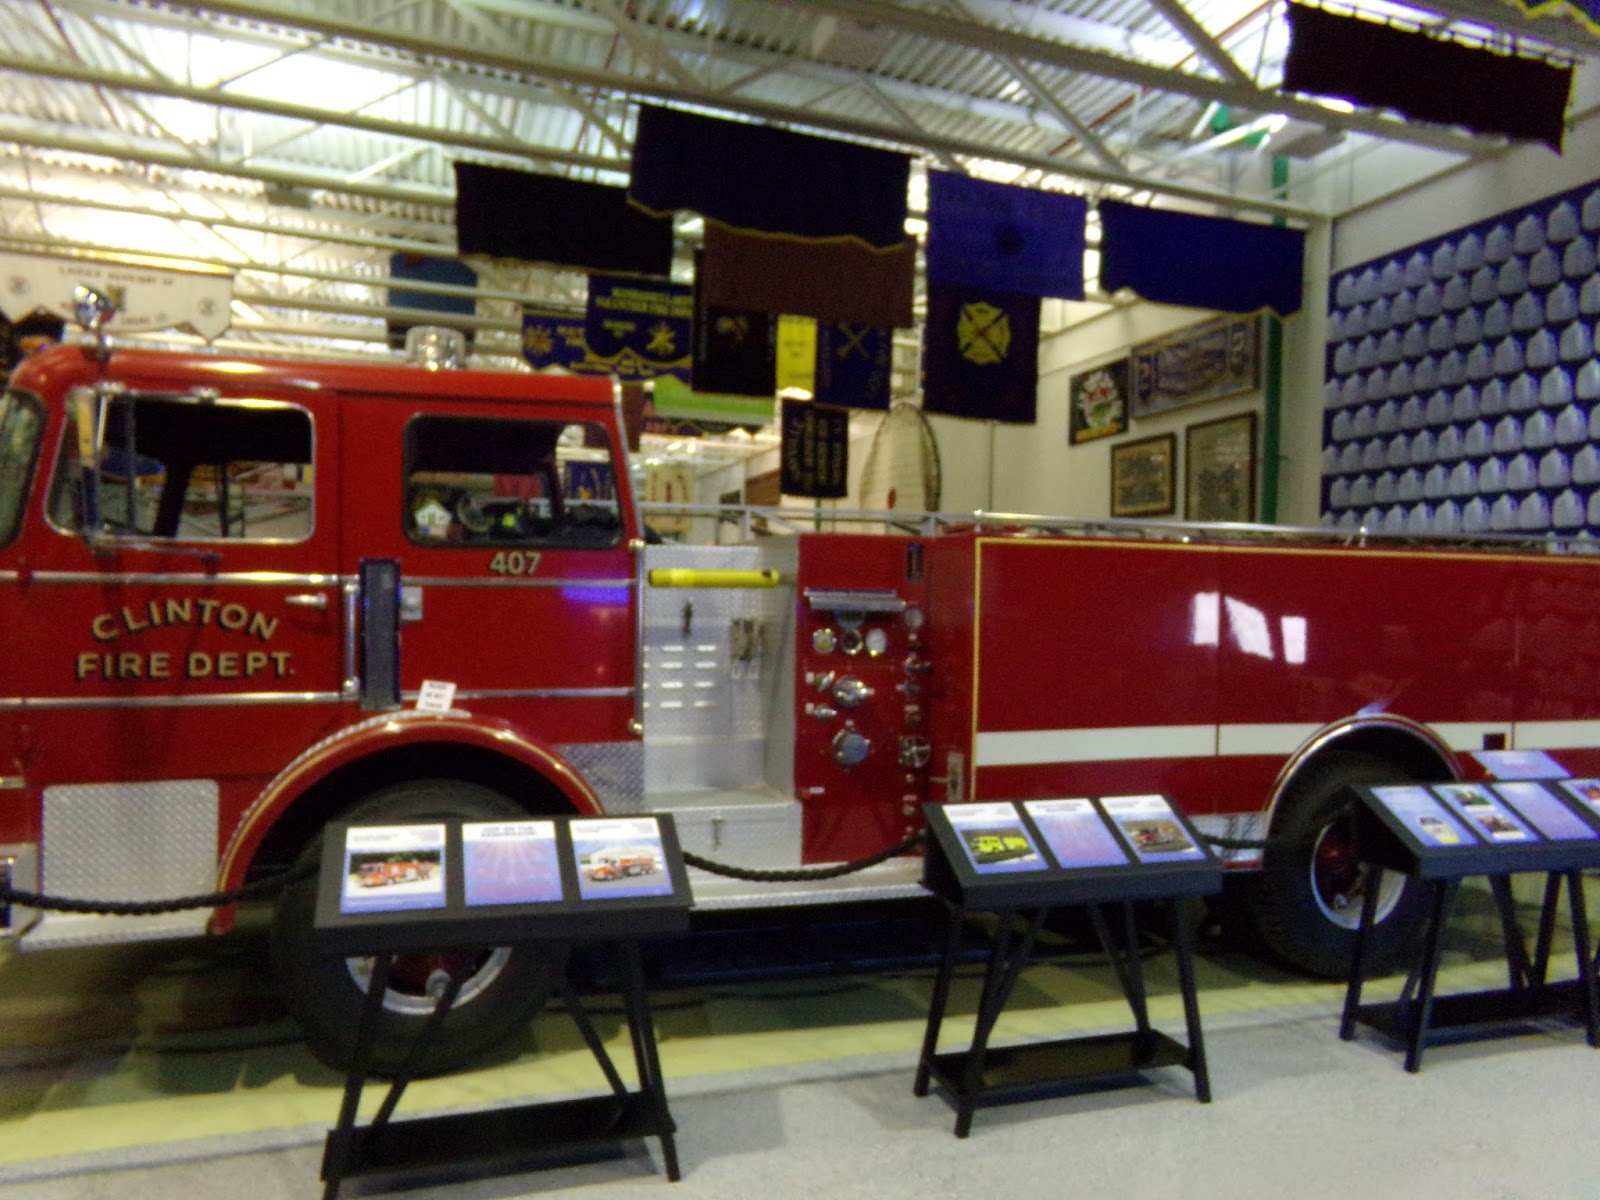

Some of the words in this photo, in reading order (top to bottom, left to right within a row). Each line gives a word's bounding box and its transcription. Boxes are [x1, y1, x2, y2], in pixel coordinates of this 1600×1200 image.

[489, 551, 541, 575] 407
[91, 597, 279, 641] CLINTON
[77, 651, 172, 680] FIRE
[188, 651, 296, 679] DEPT.
